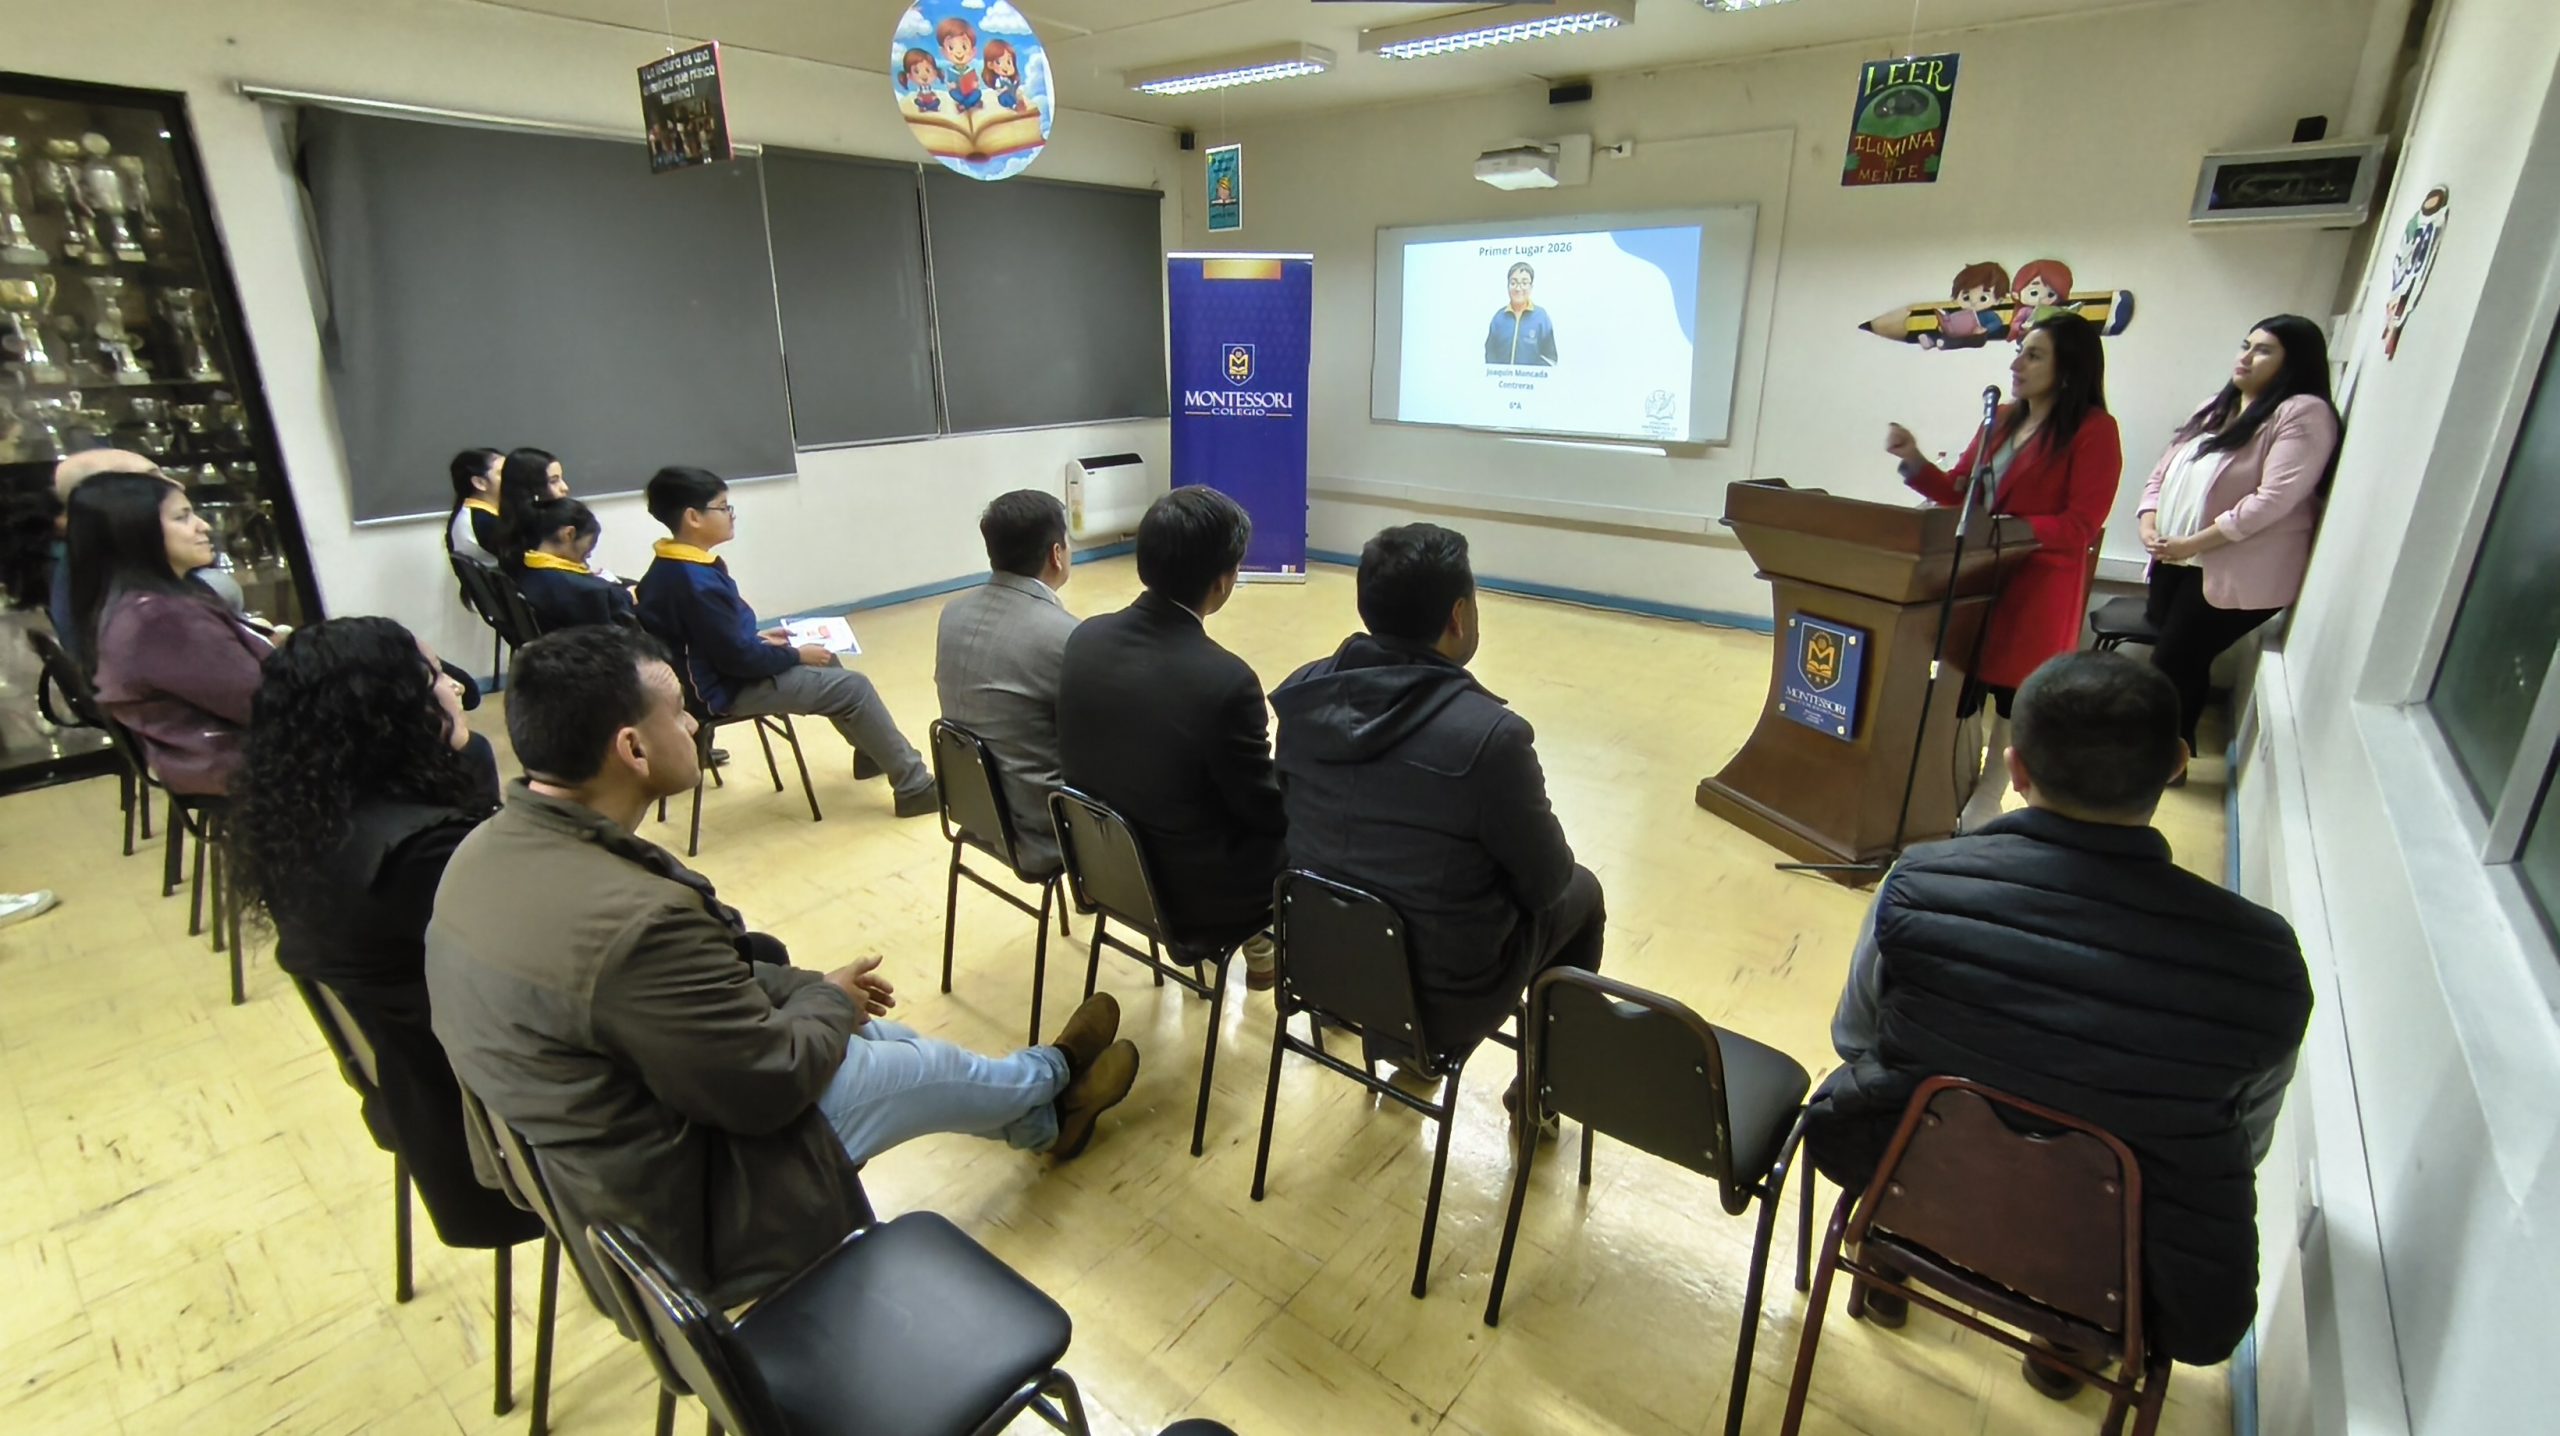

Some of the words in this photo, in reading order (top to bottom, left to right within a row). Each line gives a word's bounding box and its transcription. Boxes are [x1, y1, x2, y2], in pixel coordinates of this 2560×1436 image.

[682, 54, 692, 67] es
[693, 49, 710, 63] una
[674, 71, 689, 88] que
[690, 64, 715, 80] nunca
[1864, 60, 1951, 97] LEER
[1855, 131, 1935, 158] ILUMINA
[1858, 164, 1918, 182] MENTE
[1479, 246, 1512, 256] Primer
[1515, 244, 1544, 257] Lugar
[1547, 242, 1573, 253] 2026
[1498, 380, 1534, 390] Contreras
[1185, 390, 1292, 408] MONTESSORI
[1211, 407, 1265, 416] COLEGIO
[1785, 685, 1846, 715] MONTESSORI
